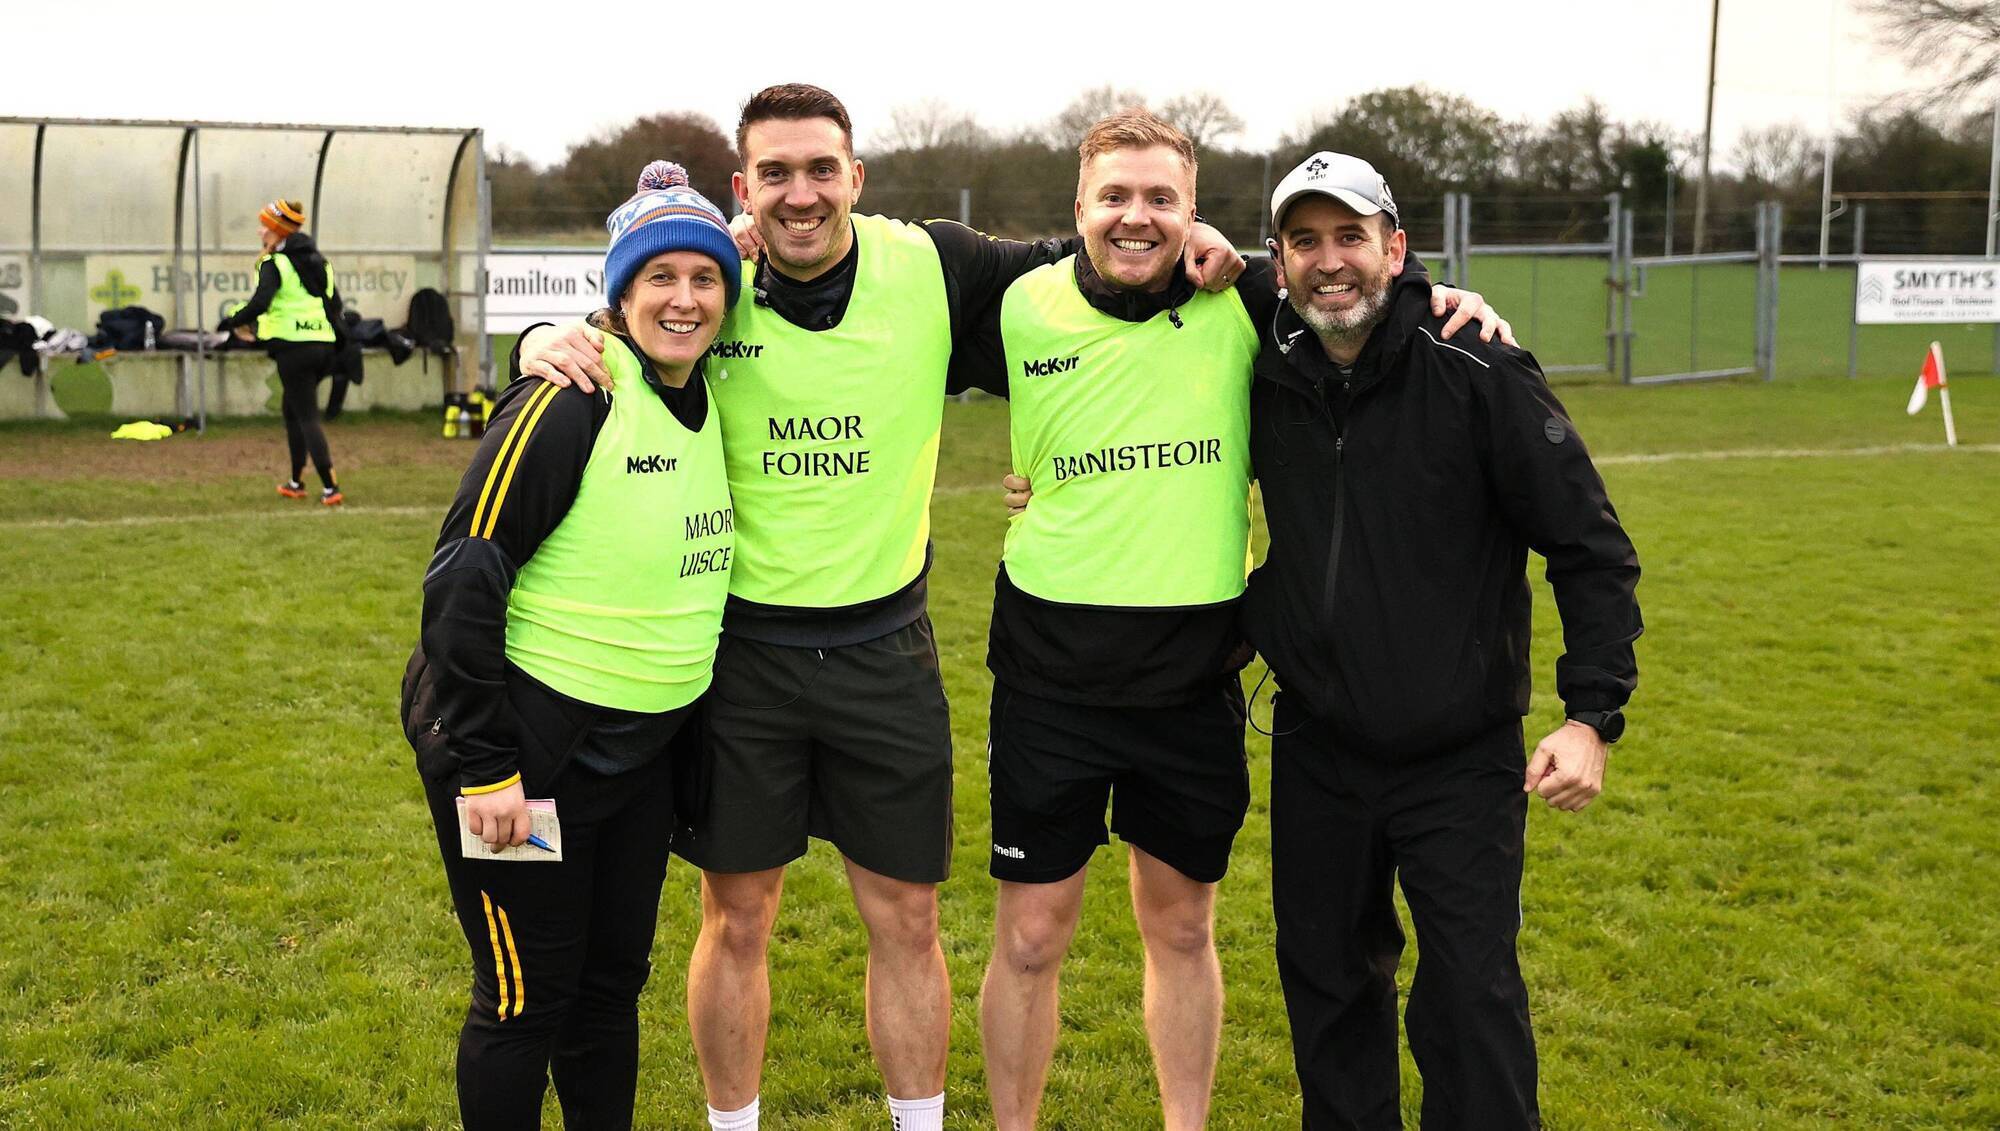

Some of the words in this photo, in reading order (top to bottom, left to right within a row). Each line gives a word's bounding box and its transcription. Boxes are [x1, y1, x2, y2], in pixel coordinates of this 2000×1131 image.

[151, 265, 250, 293] Haven
[1893, 269, 1995, 289] SMYTH'S
[768, 415, 864, 440] MAOR
[763, 450, 871, 476] FOIRNE
[685, 508, 733, 541] MAOR
[680, 547, 731, 578] UISCE
